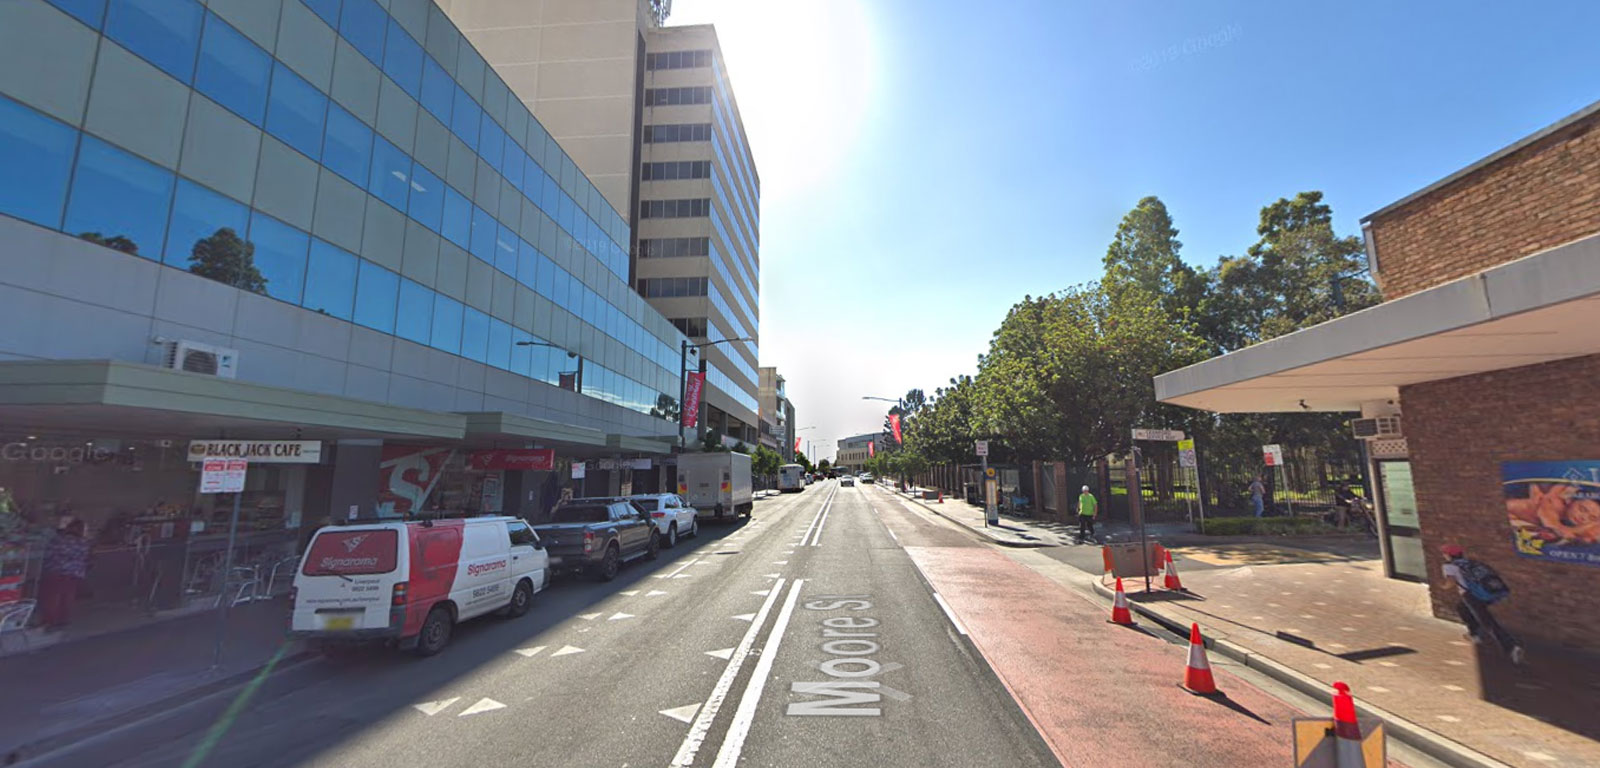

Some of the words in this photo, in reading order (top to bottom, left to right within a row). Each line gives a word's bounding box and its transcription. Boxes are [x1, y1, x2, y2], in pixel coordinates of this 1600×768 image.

[206, 443, 241, 457] BLACK
[241, 443, 271, 458] JACK
[274, 444, 302, 456] CAFE
[1549, 550, 1577, 560] OPEN
[320, 557, 378, 569] Signarama
[467, 560, 506, 577] Signarama
